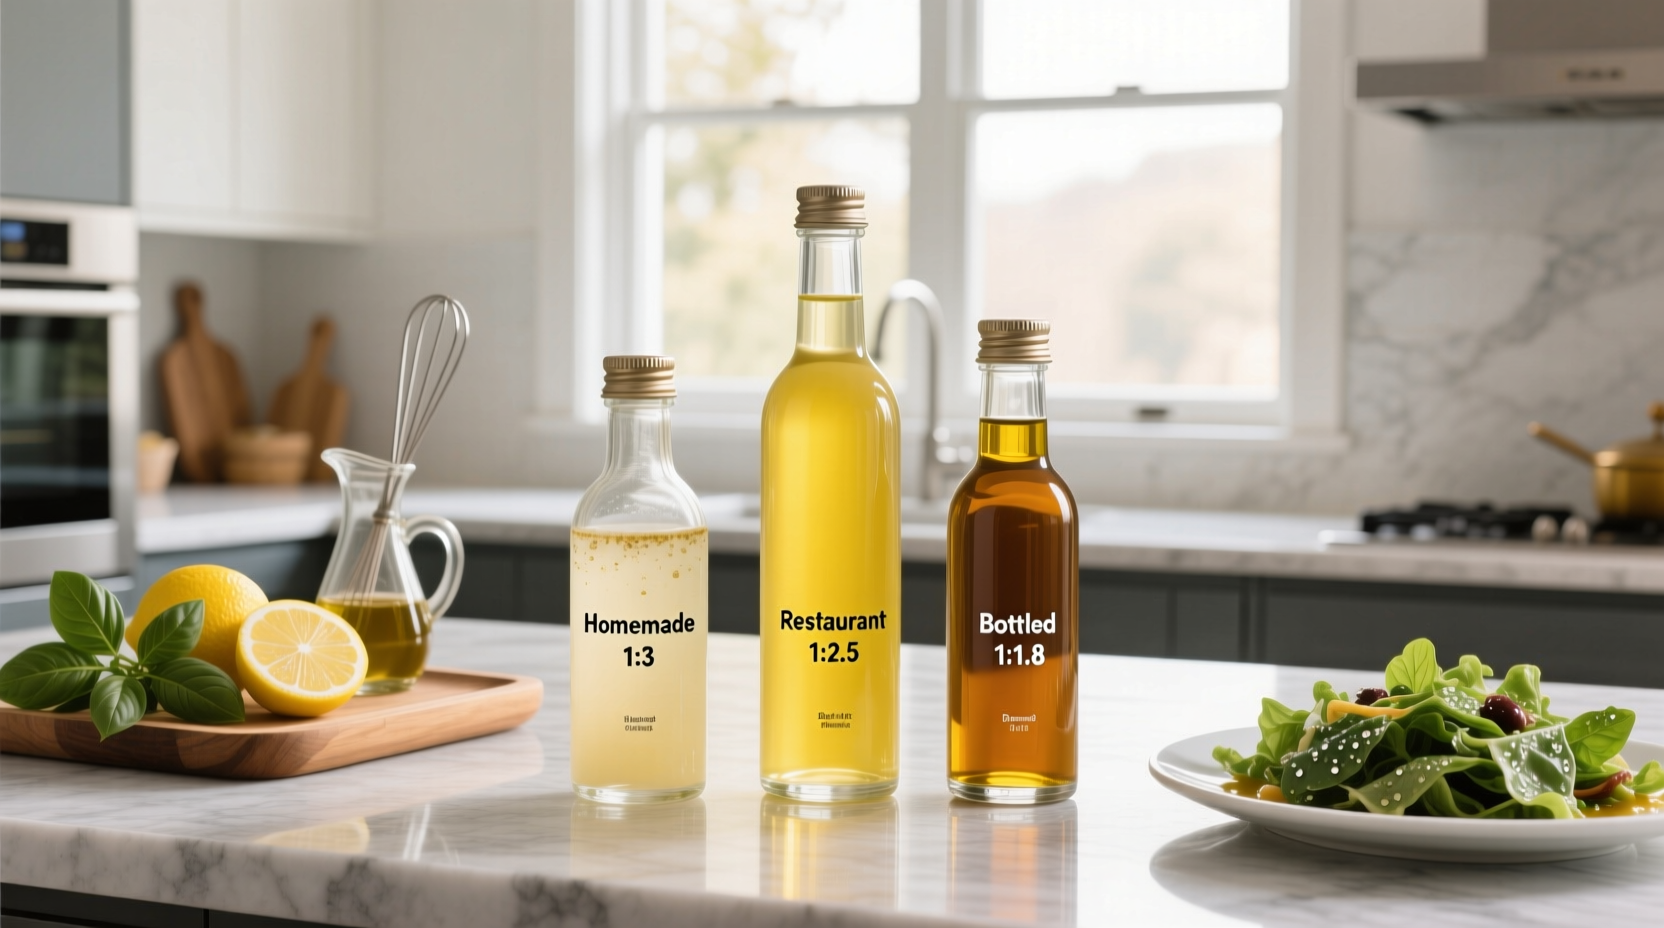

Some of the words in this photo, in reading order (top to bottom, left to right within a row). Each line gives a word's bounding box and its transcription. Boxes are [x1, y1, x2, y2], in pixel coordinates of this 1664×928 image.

[584, 611, 695, 635] Homemade
[780, 609, 887, 631] Restaurant
[979, 611, 1056, 635] Bottled
[624, 646, 655, 668] 1:3
[809, 642, 860, 664] 1:2.5
[994, 644, 1046, 666] 1:1.8
